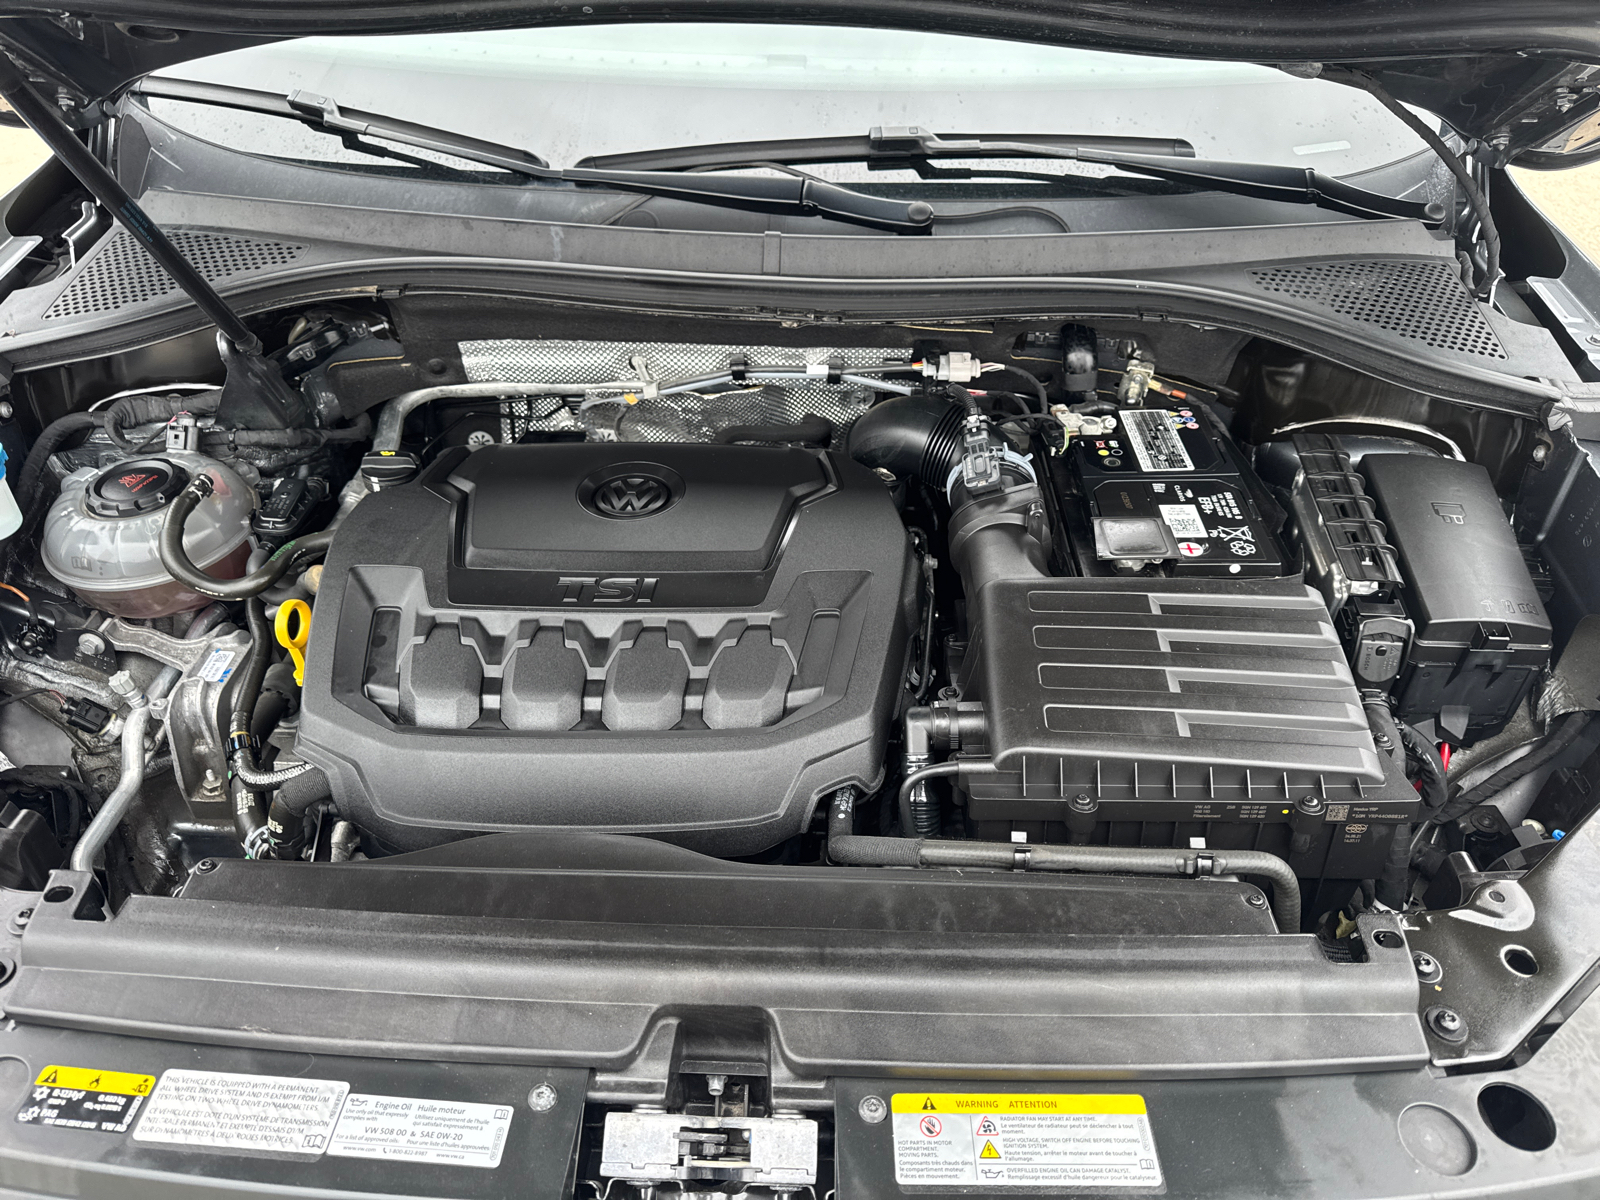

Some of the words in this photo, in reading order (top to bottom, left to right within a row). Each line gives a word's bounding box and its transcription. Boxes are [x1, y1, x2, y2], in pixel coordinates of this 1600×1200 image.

[1198, 496, 1214, 514] EFB+
[557, 576, 660, 603] TSI
[1364, 654, 1372, 670] BOSCH
[182, 1076, 208, 1085] VEHICLE
[217, 1079, 251, 1088] EQUIPPED
[277, 1084, 319, 1093] PERMANENT
[270, 1092, 296, 1100] EXEMPT
[375, 1101, 400, 1110] Engine
[1008, 1100, 1058, 1108] ATTENTION
[40, 1108, 59, 1118] PAG
[101, 1122, 115, 1130] VW
[280, 1117, 330, 1127] TRANSMISSION
[436, 1132, 463, 1140] 0W-20
